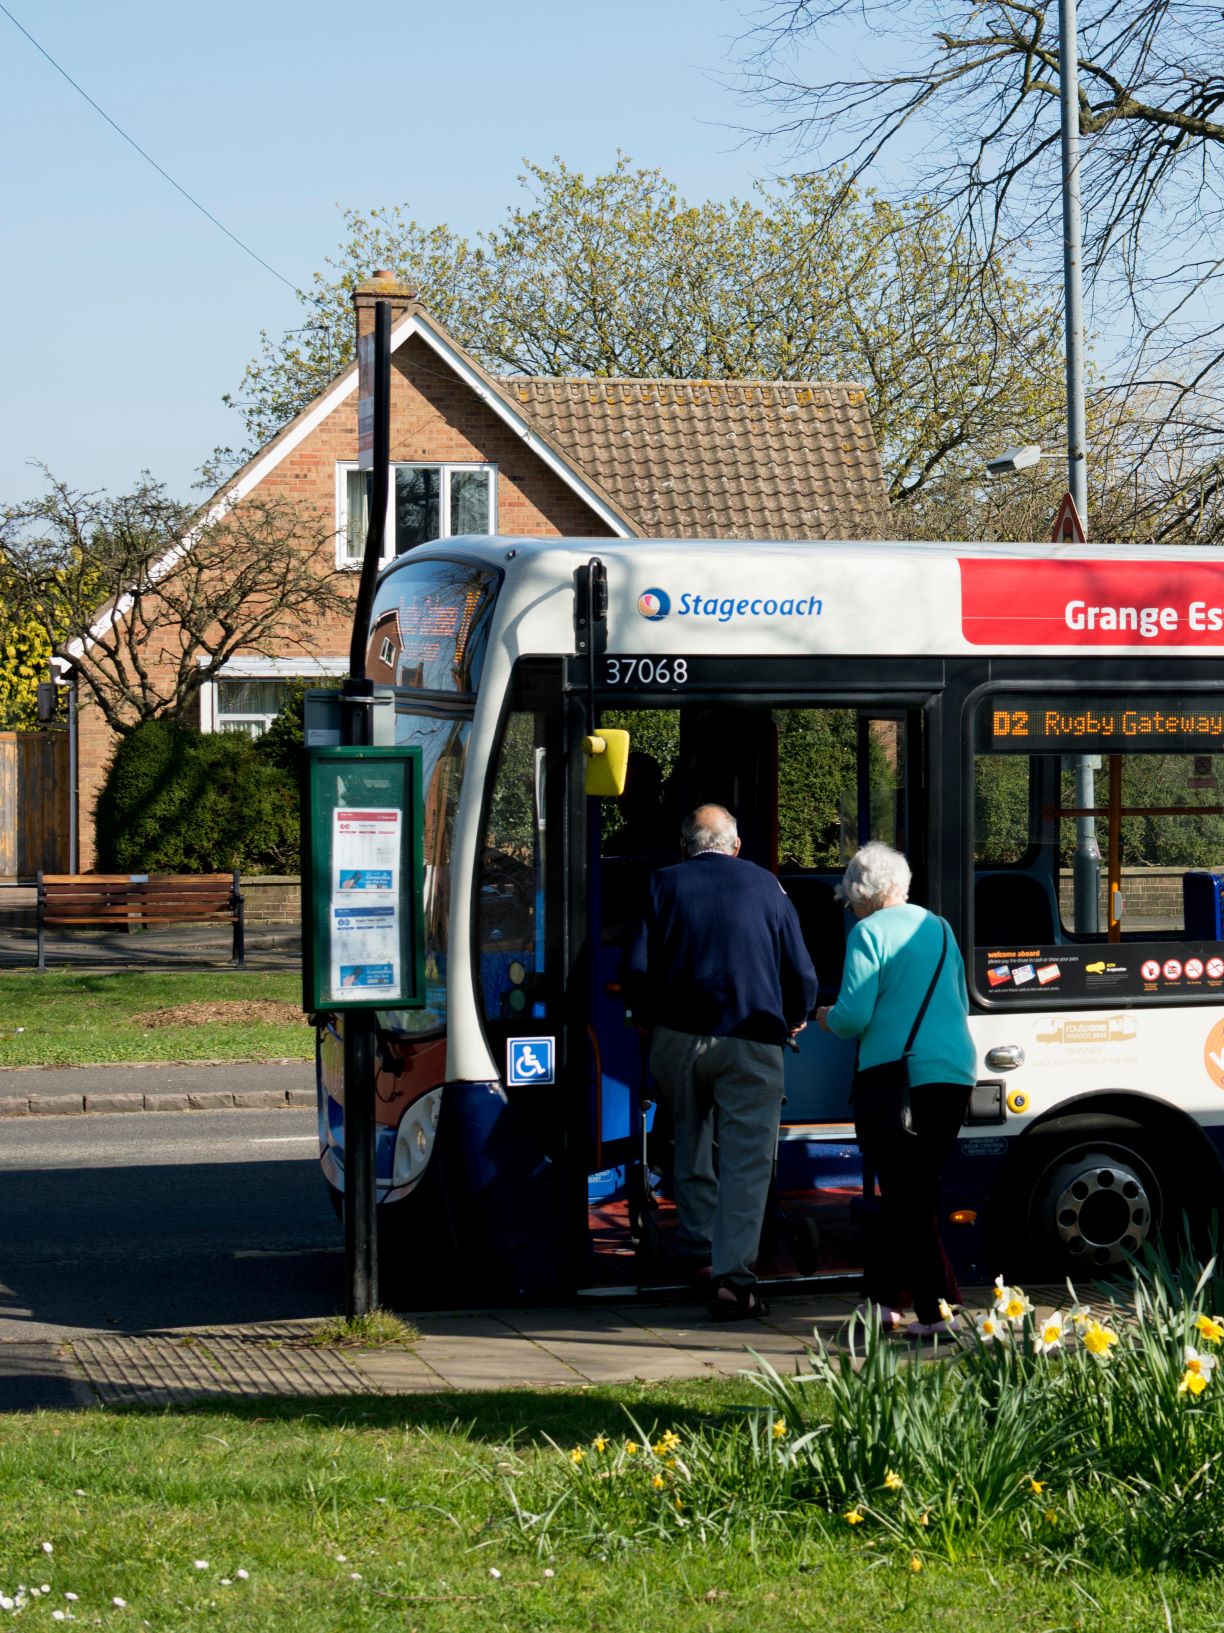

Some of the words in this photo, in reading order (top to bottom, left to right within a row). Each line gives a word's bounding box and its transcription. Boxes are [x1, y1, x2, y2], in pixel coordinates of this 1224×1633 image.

[678, 593, 823, 622] Stagecoach
[1065, 600, 1179, 638] Grange
[606, 658, 688, 684] 37068
[993, 711, 1029, 736] D2
[1045, 711, 1114, 736] Rugby
[1122, 711, 1223, 736] Gateway
[987, 950, 1017, 959] welcome
[1017, 949, 1041, 957] aboard
